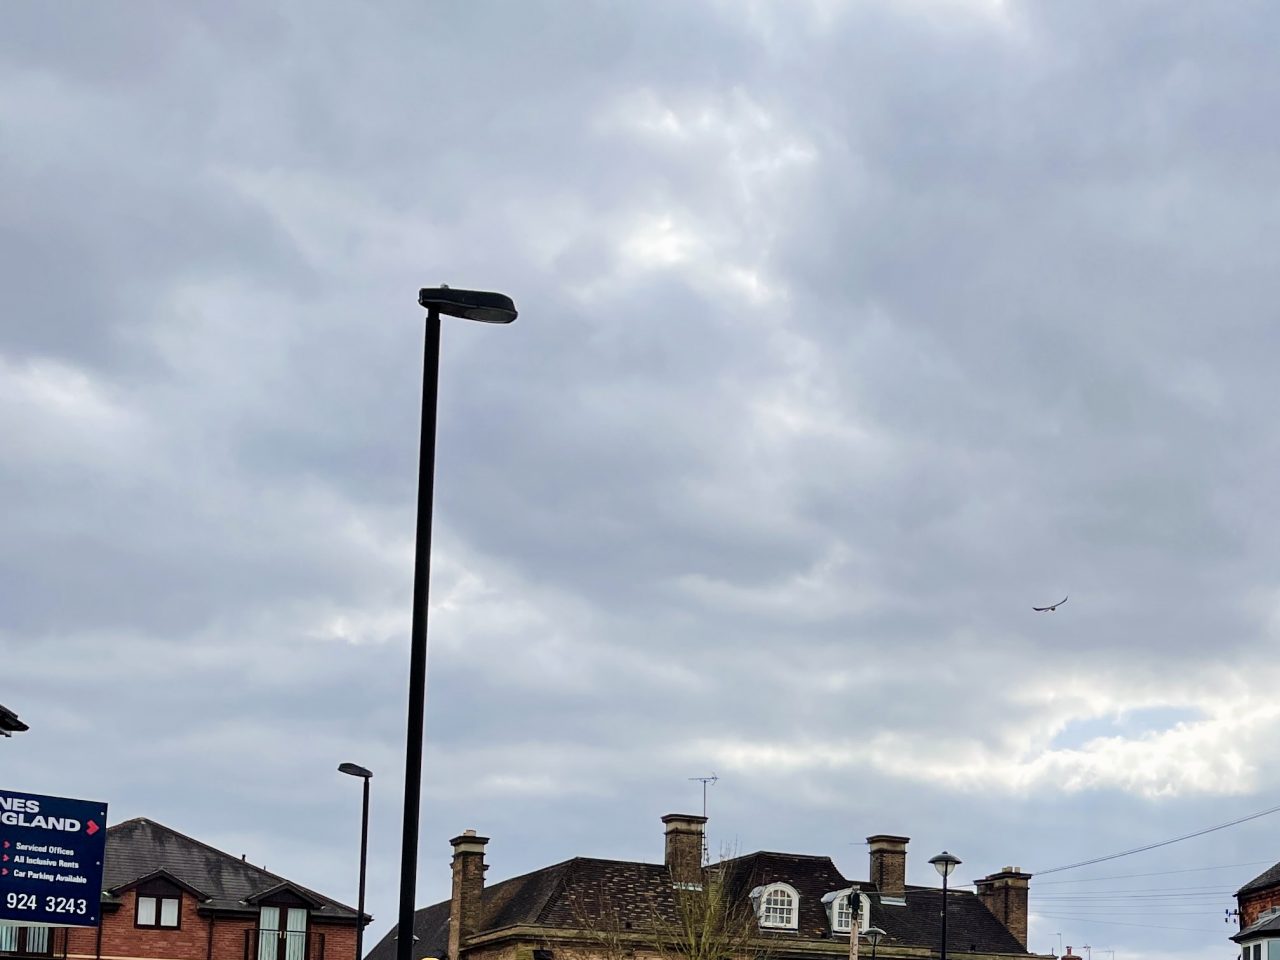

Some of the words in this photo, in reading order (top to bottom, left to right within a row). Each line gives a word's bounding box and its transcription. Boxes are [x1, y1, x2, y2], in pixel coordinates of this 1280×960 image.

[0, 811, 81, 832] GLAND
[16, 842, 47, 852] Serviced
[49, 846, 74, 856] Offices
[14, 855, 24, 863] All
[26, 856, 57, 867] Inclusive
[59, 860, 79, 869] Rents
[14, 869, 25, 878] Car
[28, 871, 54, 882] Parking
[56, 874, 87, 884] Available
[7, 893, 37, 910] 924
[45, 896, 87, 914] 3243
